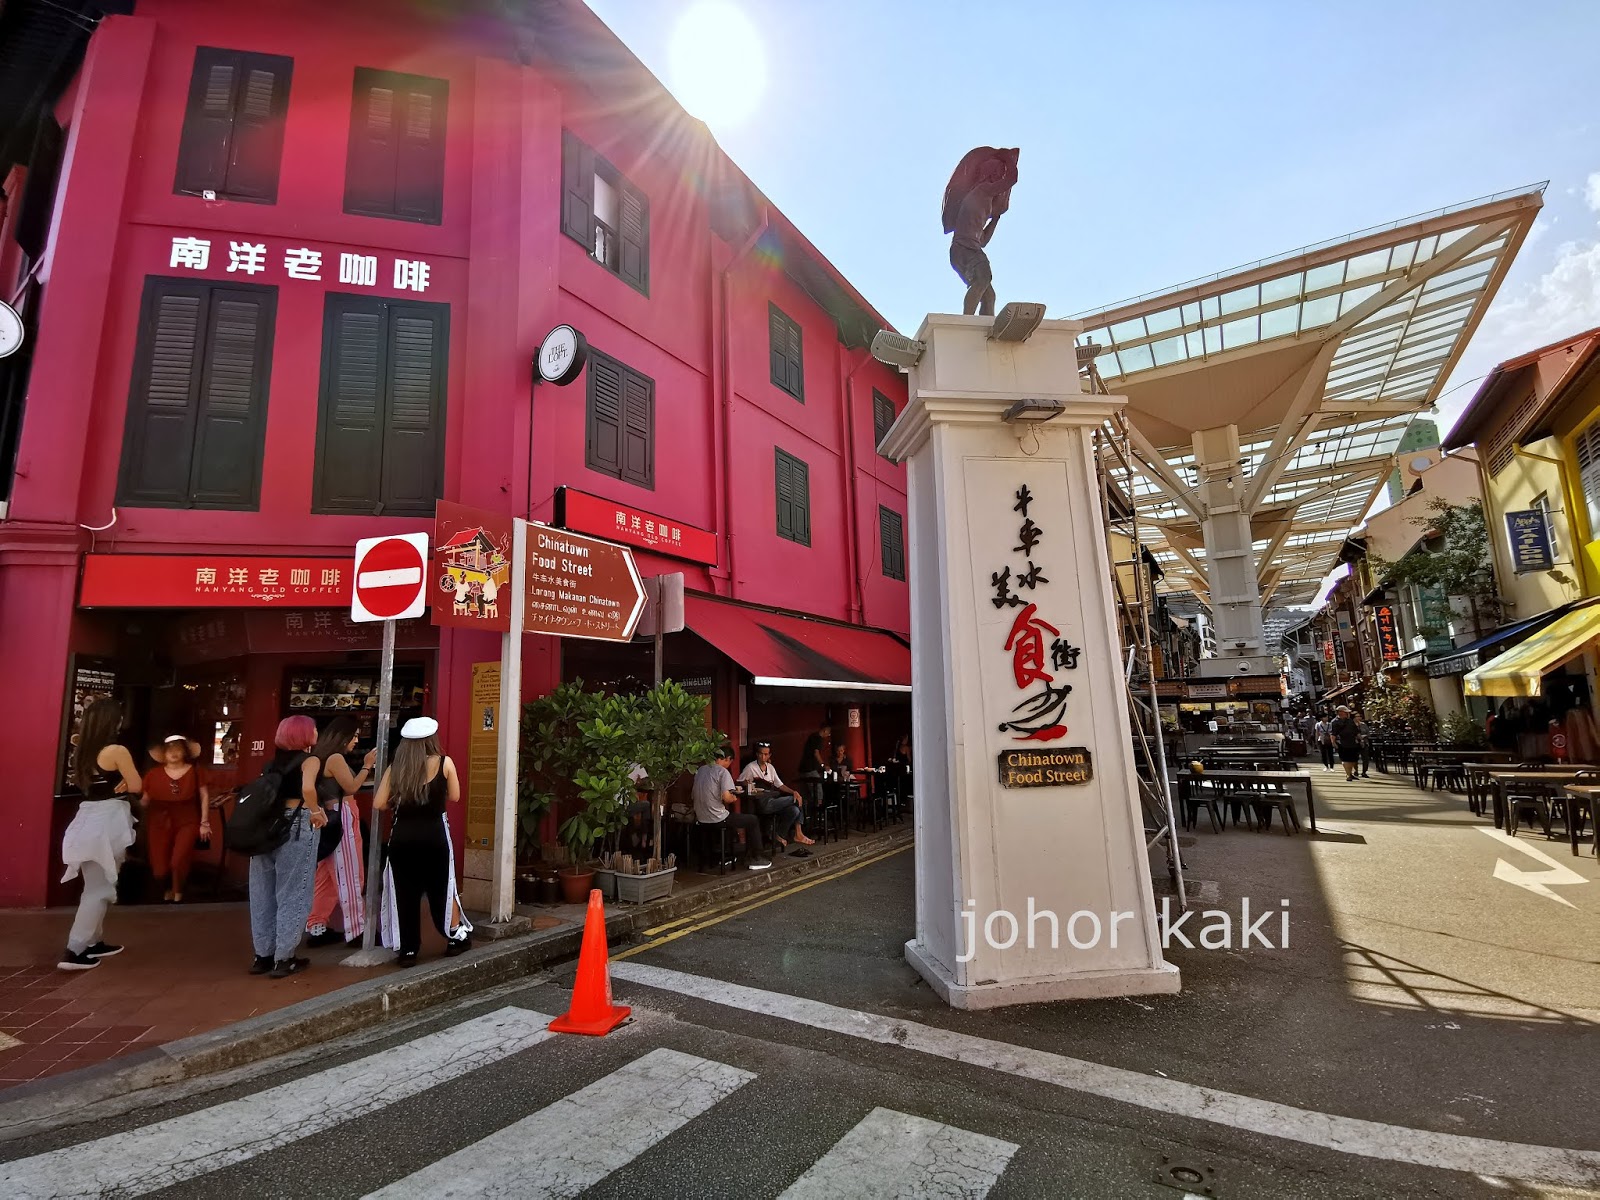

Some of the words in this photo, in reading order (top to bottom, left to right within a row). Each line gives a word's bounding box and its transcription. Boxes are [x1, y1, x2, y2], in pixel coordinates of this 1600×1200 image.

[169, 236, 431, 292] 南洋老咖啡
[616, 511, 681, 541] 南洋老咖啡
[616, 525, 644, 537] NANYANG
[661, 537, 682, 546] COFFEE
[1013, 483, 1049, 589] 牛車水
[537, 533, 589, 558] Chinatown
[532, 552, 556, 570] Food
[561, 558, 593, 577] Street
[195, 567, 341, 586] 南洋老咖啡
[294, 586, 340, 594] COFFEE
[558, 590, 587, 603] Makanan
[589, 594, 620, 608] Chinatown
[1007, 752, 1084, 767] Chinatown
[1008, 769, 1043, 784] Food
[1046, 769, 1086, 783] Street
